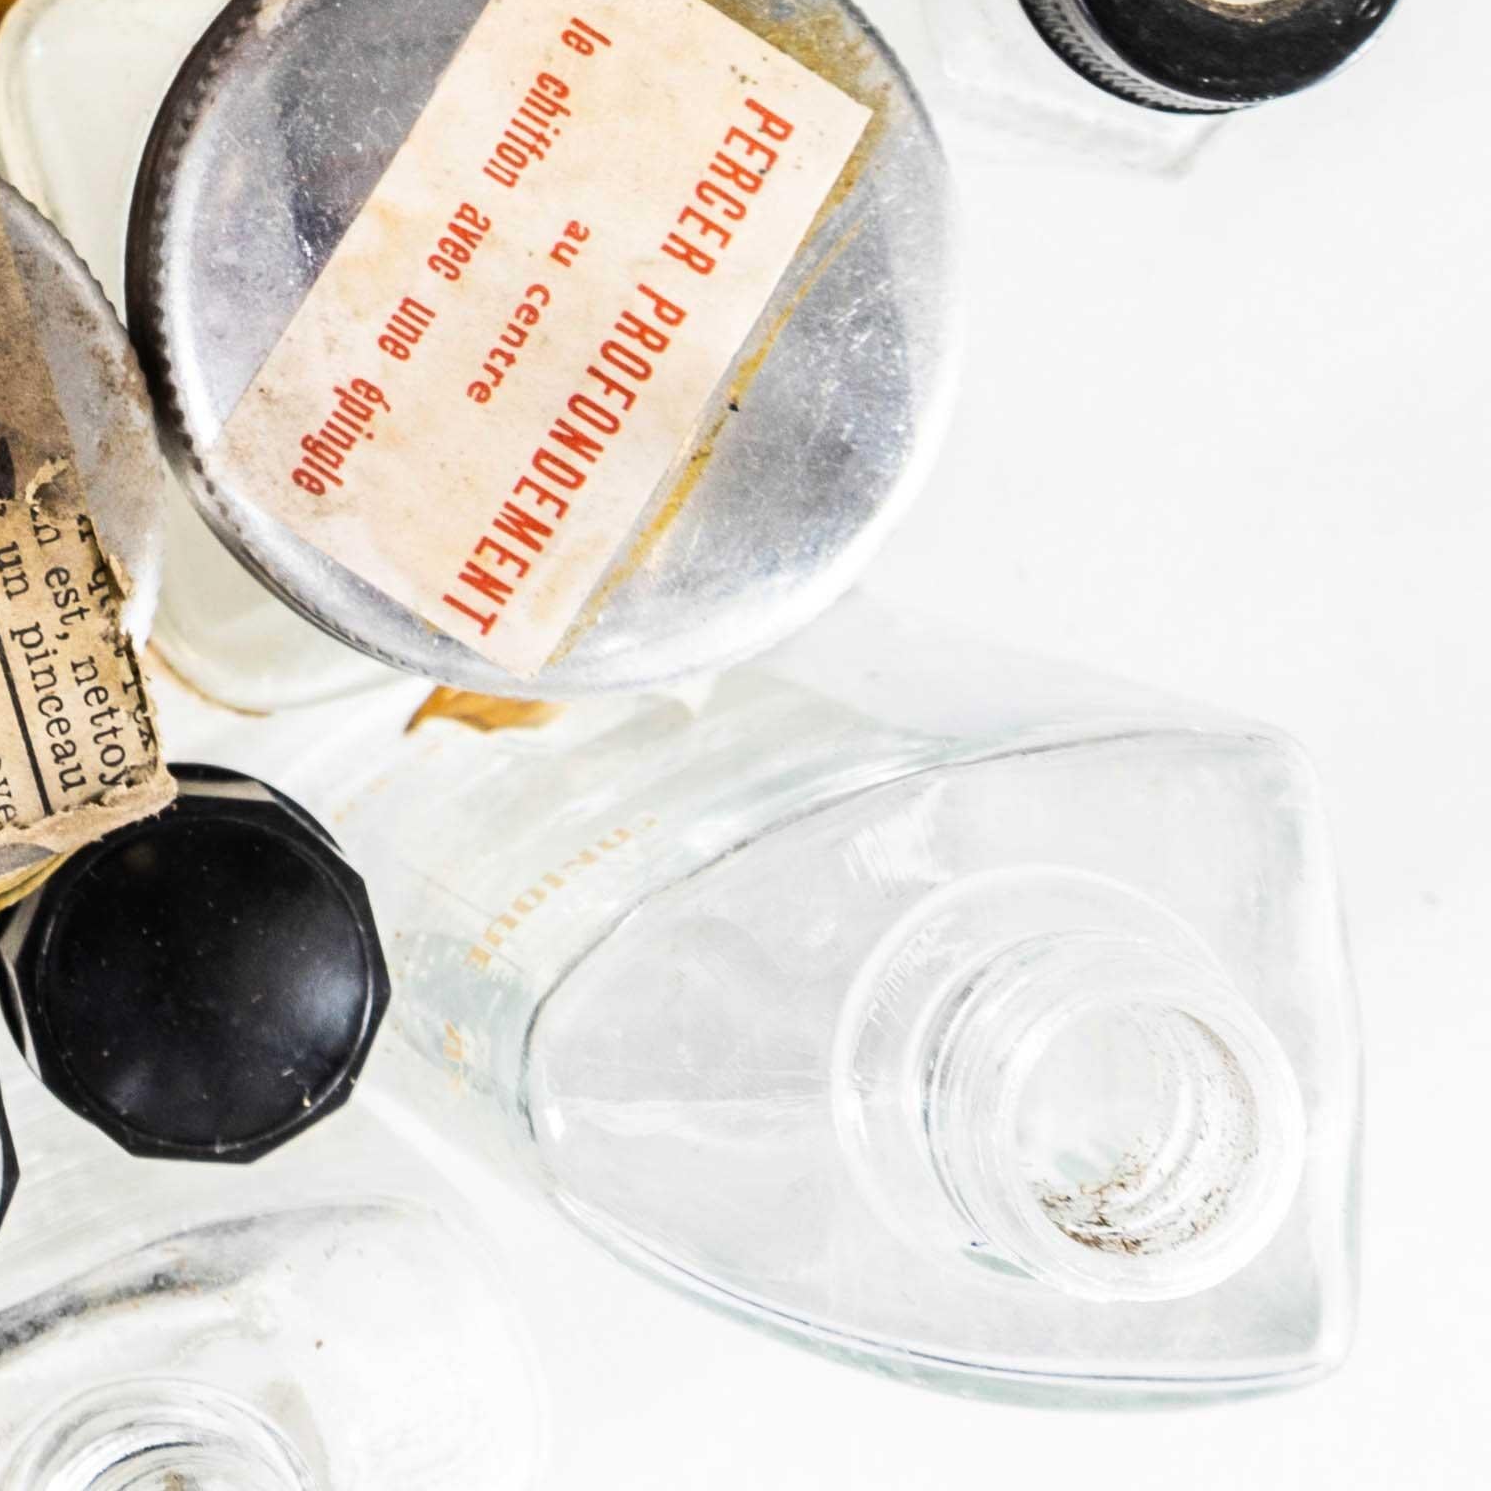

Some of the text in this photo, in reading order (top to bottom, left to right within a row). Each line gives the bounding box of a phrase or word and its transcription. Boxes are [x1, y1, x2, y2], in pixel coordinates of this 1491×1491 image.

[289, 16, 612, 499] le chiffon avec une épingle
[440, 96, 797, 637] PERCER PROFONDEMENT
[465, 219, 592, 405] au centre
[11, 622, 91, 795] pinceau
